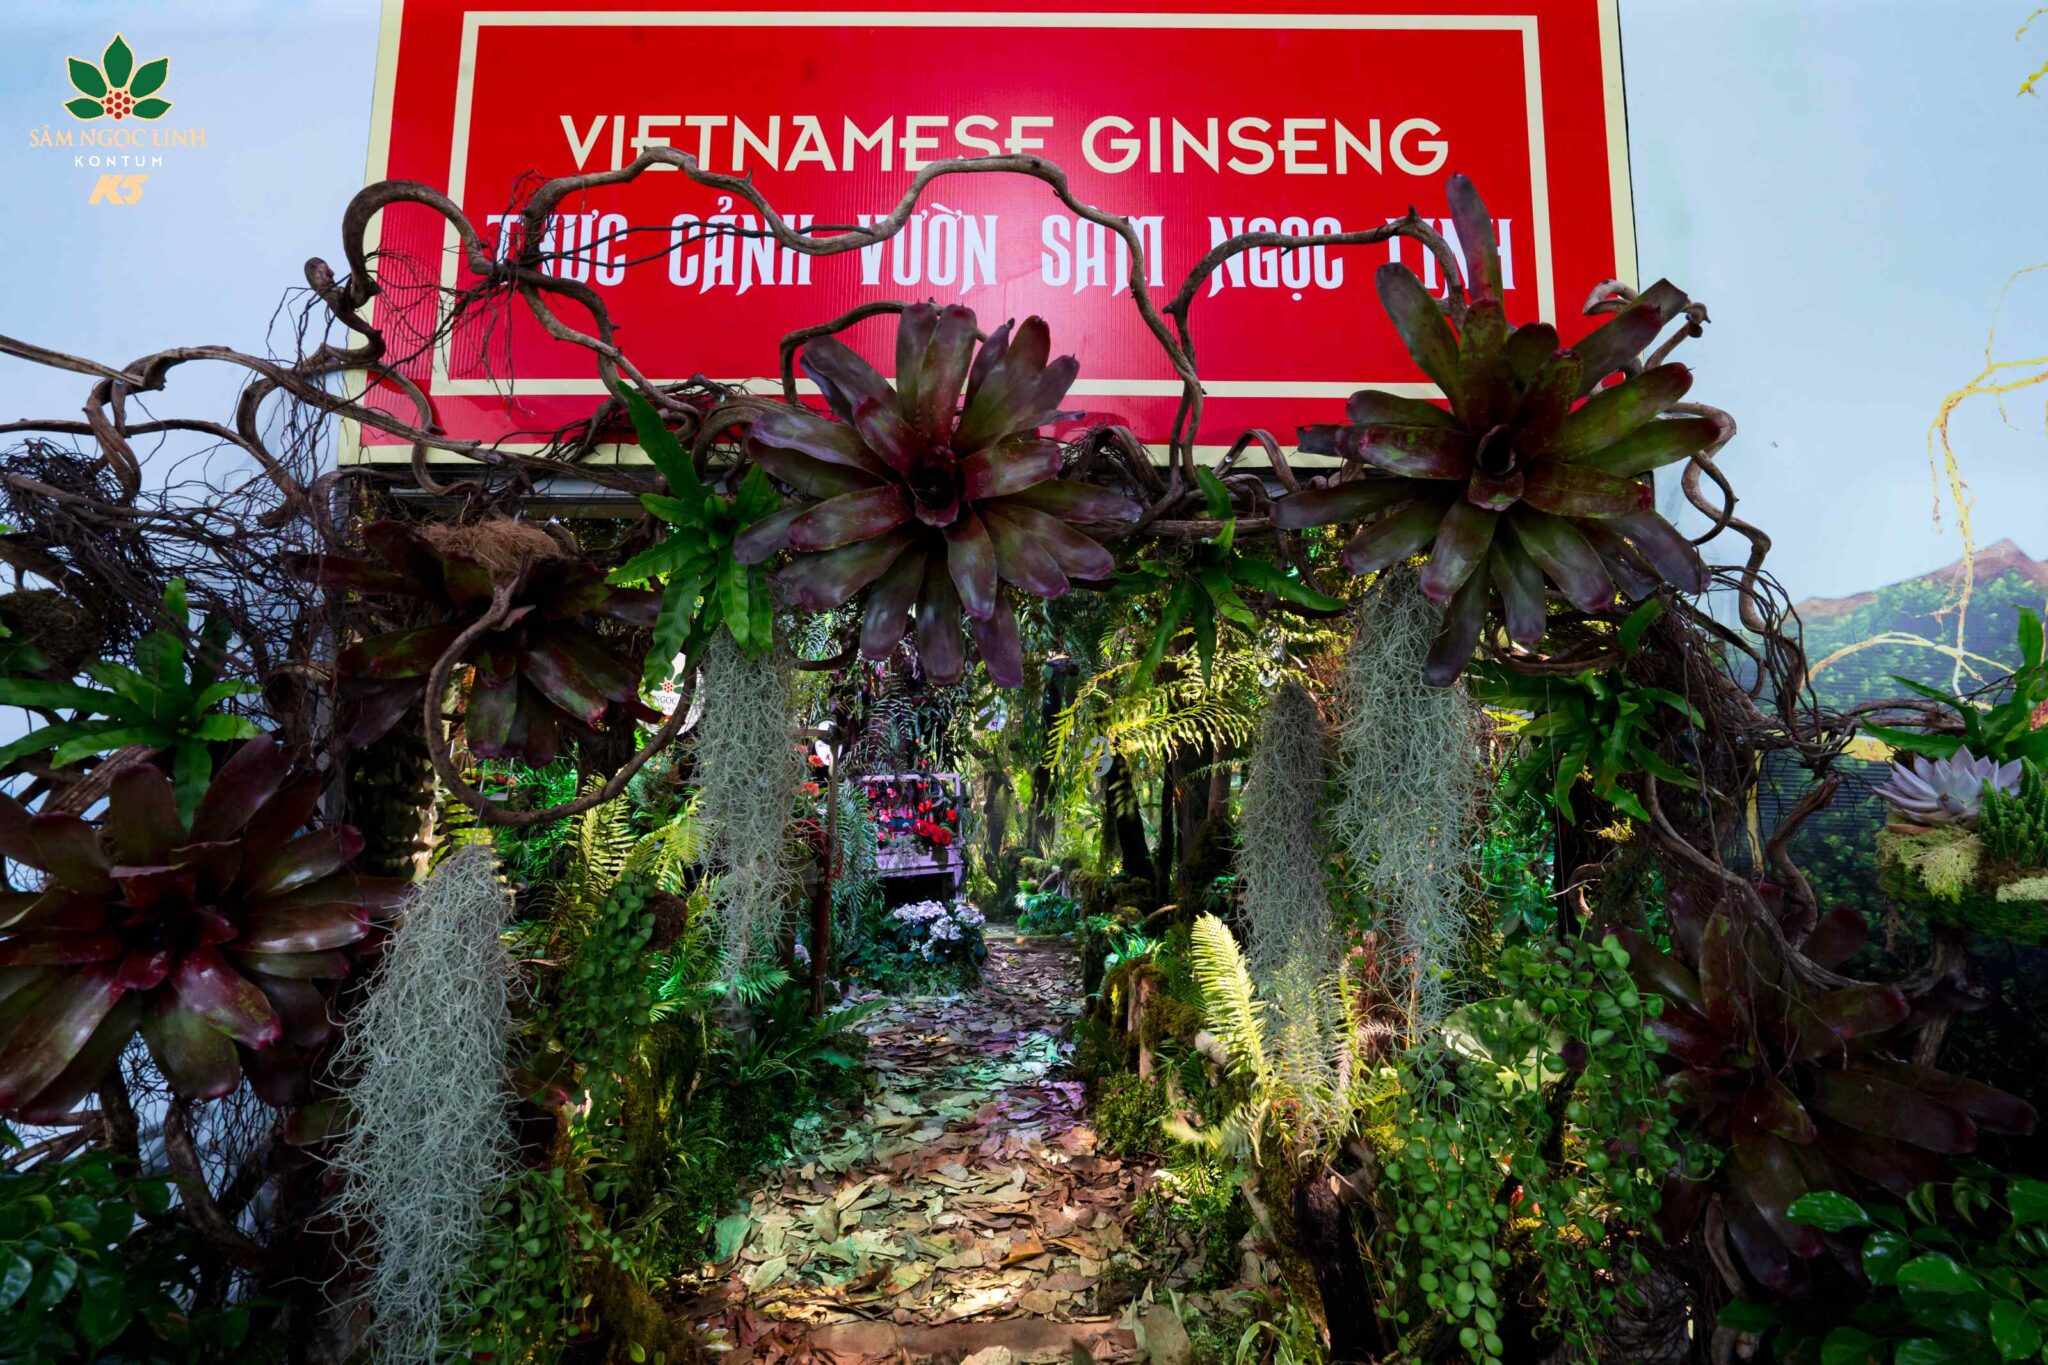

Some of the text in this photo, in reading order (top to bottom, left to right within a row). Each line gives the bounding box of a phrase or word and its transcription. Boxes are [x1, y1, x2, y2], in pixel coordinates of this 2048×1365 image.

[560, 114, 1450, 177] VIETNAMESE GINSENG
[668, 195, 816, 297] CẢNH
[1207, 216, 1345, 302] NGỌC
